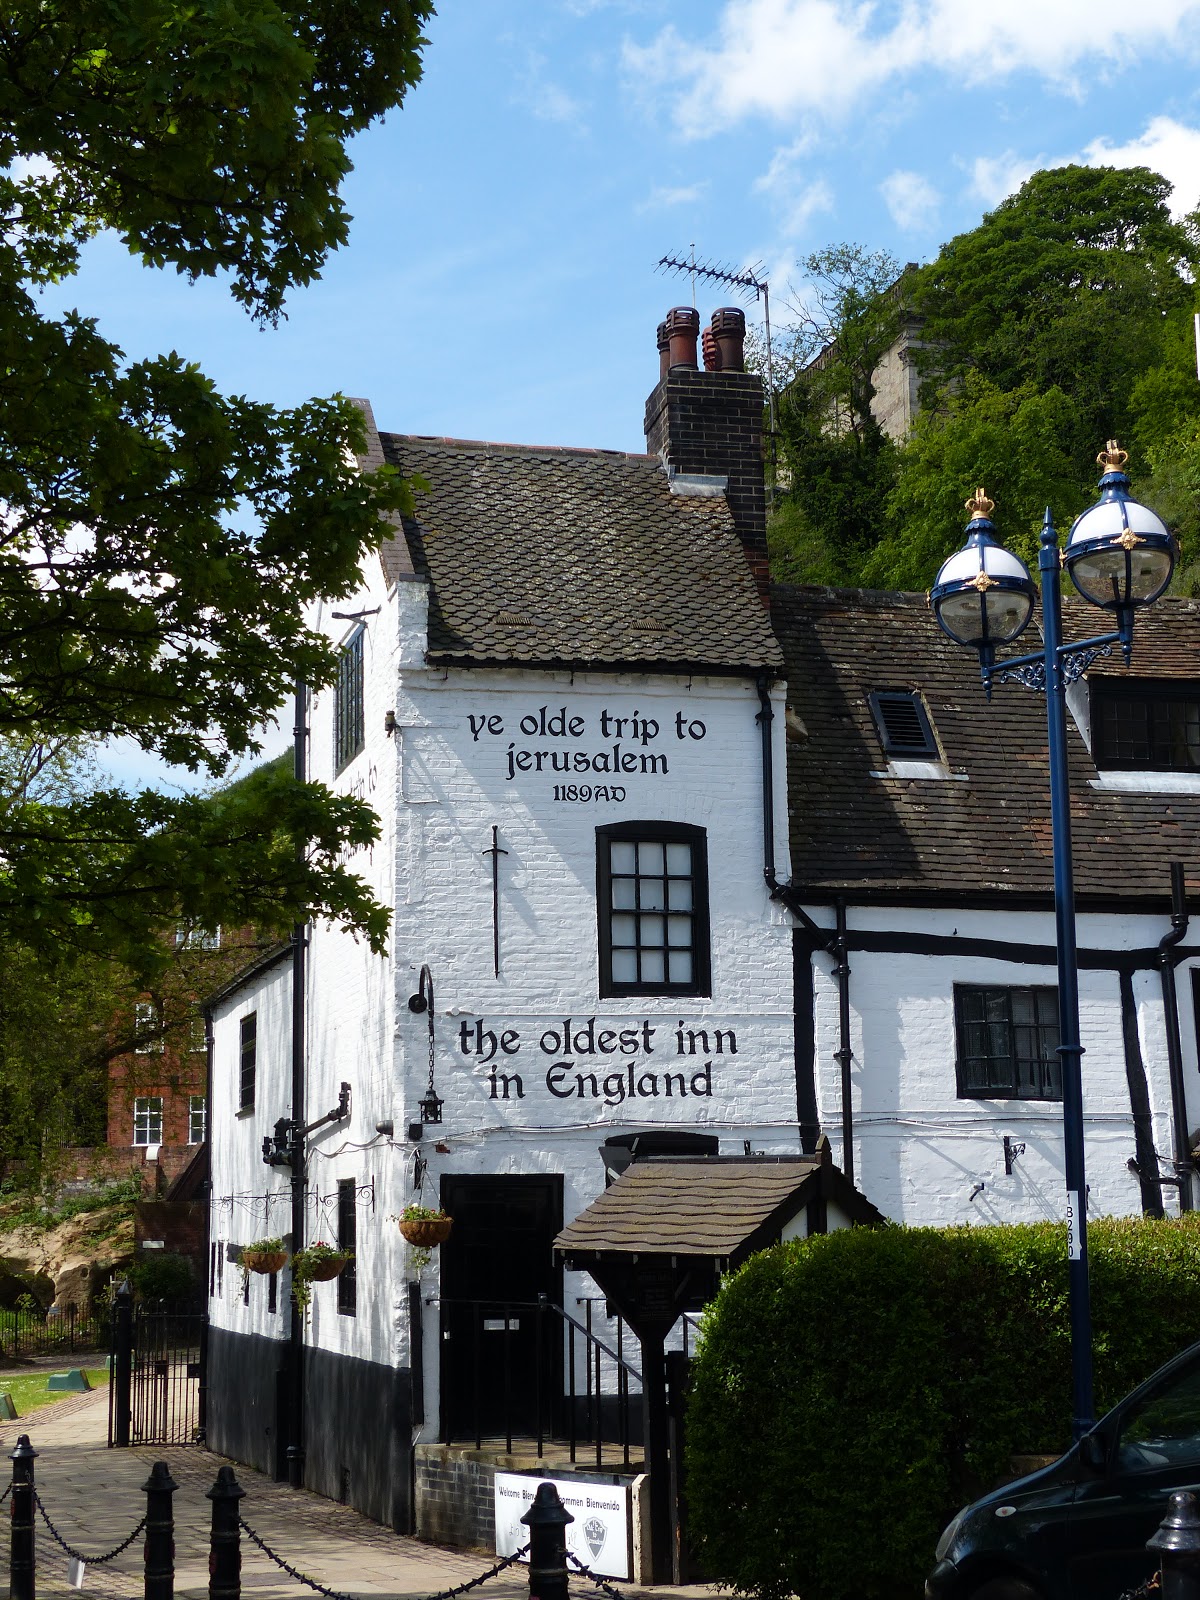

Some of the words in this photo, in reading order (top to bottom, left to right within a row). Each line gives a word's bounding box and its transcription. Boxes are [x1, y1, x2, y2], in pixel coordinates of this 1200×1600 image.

[466, 714, 505, 743] ye
[519, 705, 586, 738] olde
[599, 708, 660, 746] trip
[674, 710, 707, 740] to
[505, 742, 670, 781] jerusalem
[552, 784, 627, 802] 1189AD
[458, 1018, 521, 1064] the
[539, 1017, 657, 1055] oldest
[674, 1019, 739, 1055] inn
[486, 1064, 526, 1100] in
[545, 1060, 713, 1107] England
[498, 1486, 521, 1499] Welcome
[586, 1498, 620, 1511] Bienvenido
